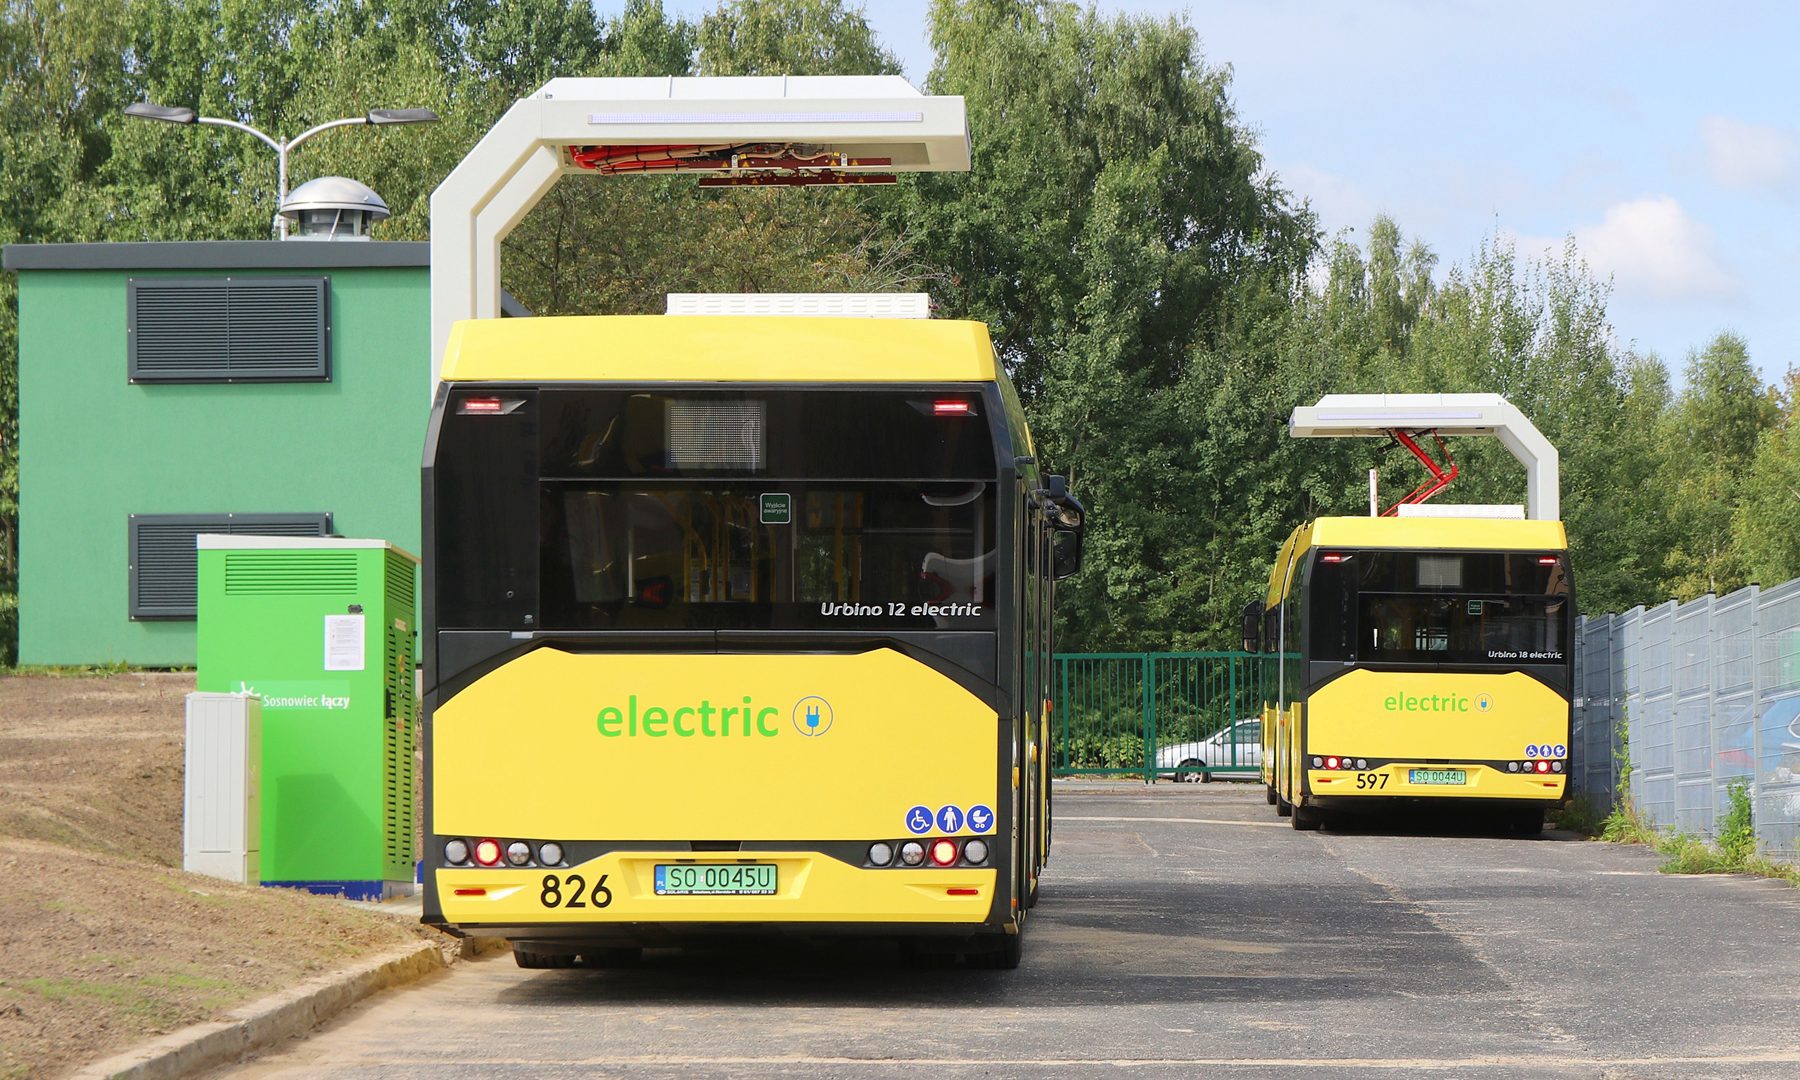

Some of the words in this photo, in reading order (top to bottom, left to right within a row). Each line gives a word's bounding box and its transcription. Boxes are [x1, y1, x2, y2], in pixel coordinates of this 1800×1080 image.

[820, 602, 883, 616] Urbino
[888, 602, 906, 616] 12
[911, 602, 982, 616] electric
[1488, 650, 1517, 658] Urbino
[1519, 651, 1528, 659] 18
[1529, 651, 1563, 659] electric
[263, 694, 318, 707] Sosnowiec
[321, 694, 350, 710] łączy
[1384, 691, 1469, 712] electric
[596, 694, 779, 737] electric
[1356, 773, 1390, 790] 597
[670, 868, 697, 888] SO
[705, 868, 770, 888] 0045U
[540, 874, 613, 909] 826
